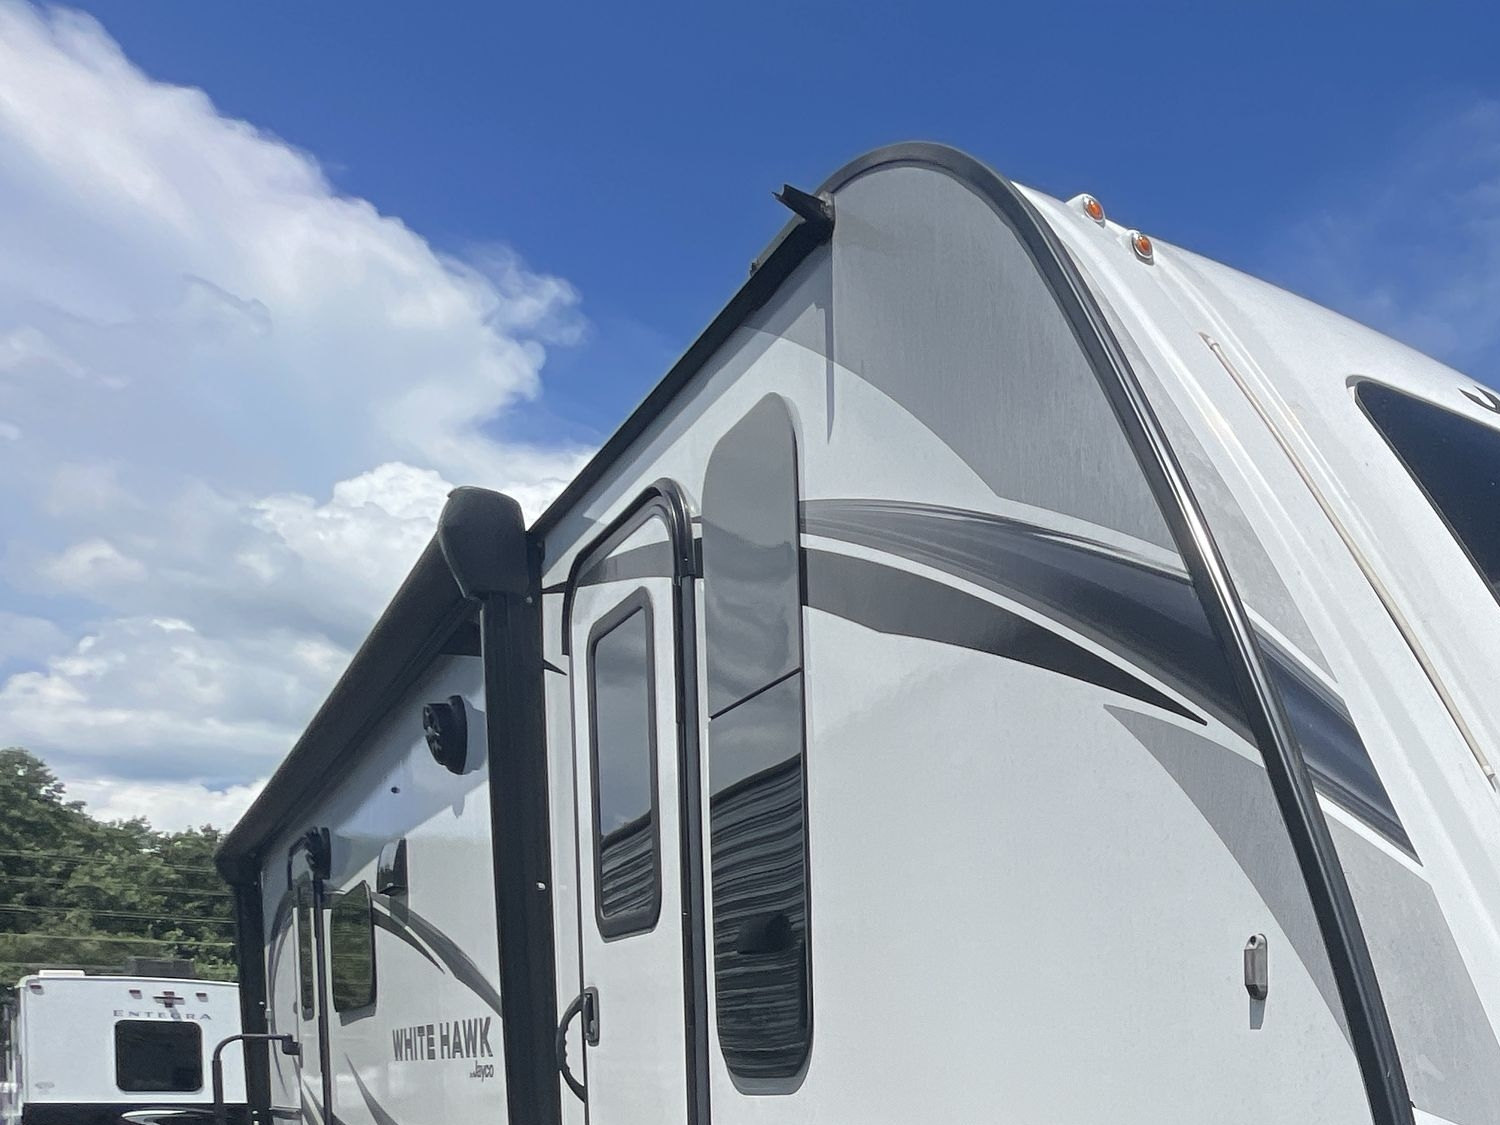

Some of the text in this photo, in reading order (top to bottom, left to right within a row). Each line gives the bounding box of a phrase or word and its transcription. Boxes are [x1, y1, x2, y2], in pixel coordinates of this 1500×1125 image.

[113, 1009, 212, 1020] ENTEGRA
[392, 1016, 494, 1061] WHITE HAWK
